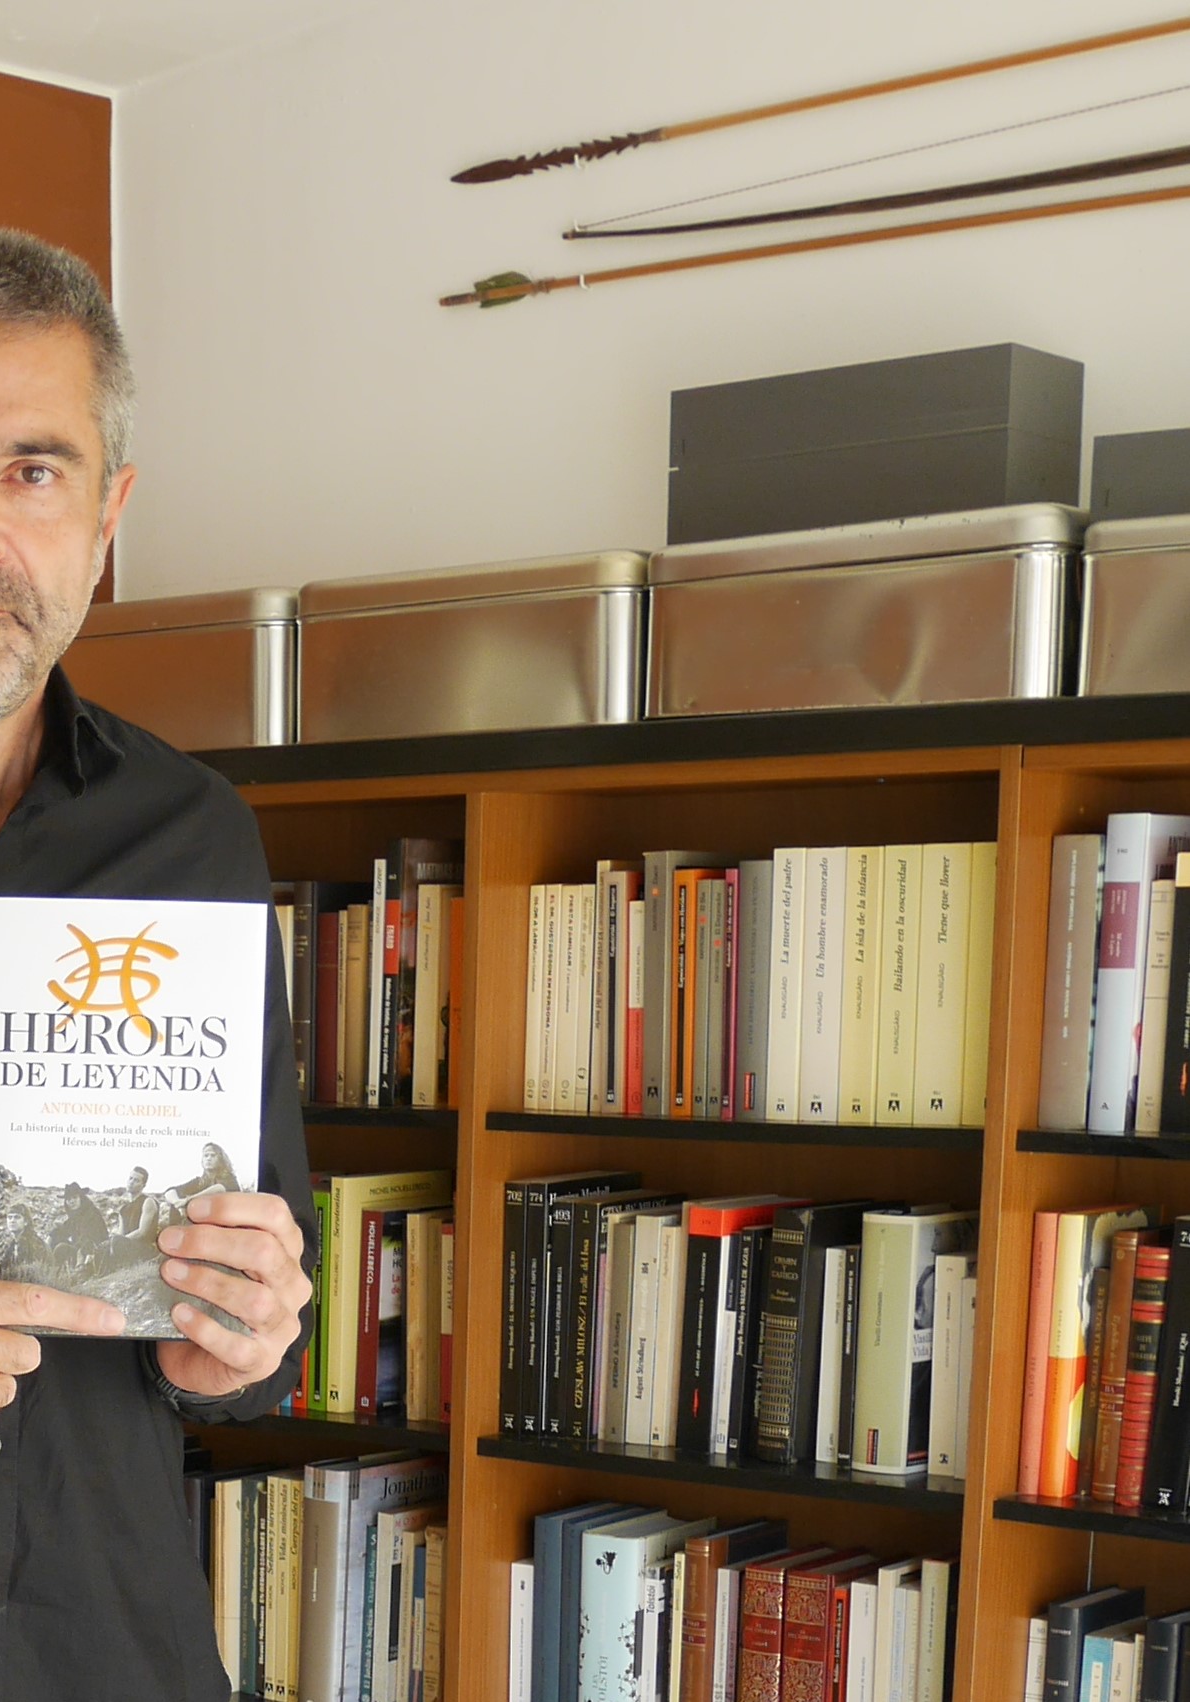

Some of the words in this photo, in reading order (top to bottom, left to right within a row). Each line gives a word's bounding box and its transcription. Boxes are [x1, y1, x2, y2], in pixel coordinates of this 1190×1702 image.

[783, 858, 794, 889] padre
[857, 854, 868, 897] infancia
[939, 856, 950, 886] llover
[819, 857, 829, 916] enamorado
[895, 860, 907, 913] oscuridad
[782, 891, 792, 907] del
[857, 900, 866, 909] la
[941, 890, 950, 910] que
[781, 910, 791, 947] muerte
[856, 913, 866, 924] de
[895, 916, 905, 925] la
[937, 914, 948, 944] Tiene
[816, 919, 827, 959] hombre
[854, 929, 865, 946] isla
[896, 928, 905, 941] en
[780, 950, 790, 964] La
[854, 949, 865, 963] La
[815, 963, 825, 978] Un
[893, 944, 905, 992] Bailando
[0, 1001, 228, 1058] HÉROES
[0, 1062, 47, 1087] DE
[61, 1063, 226, 1092] LEYENDA
[40, 1102, 110, 1116] ANTONIO
[115, 1104, 181, 1118] CARDIEL
[10, 1122, 22, 1132] La
[25, 1123, 64, 1133] historia
[66, 1124, 78, 1133] de
[81, 1126, 100, 1134] una
[103, 1125, 133, 1134] banda
[136, 1125, 147, 1135] de
[151, 1126, 173, 1136] rock
[176, 1127, 211, 1137] mítica:
[62, 1137, 97, 1147] Héroes
[100, 1138, 115, 1147] del
[118, 1138, 158, 1148] Silencio
[635, 1337, 647, 1374] Strindberg
[635, 1376, 645, 1399] August
